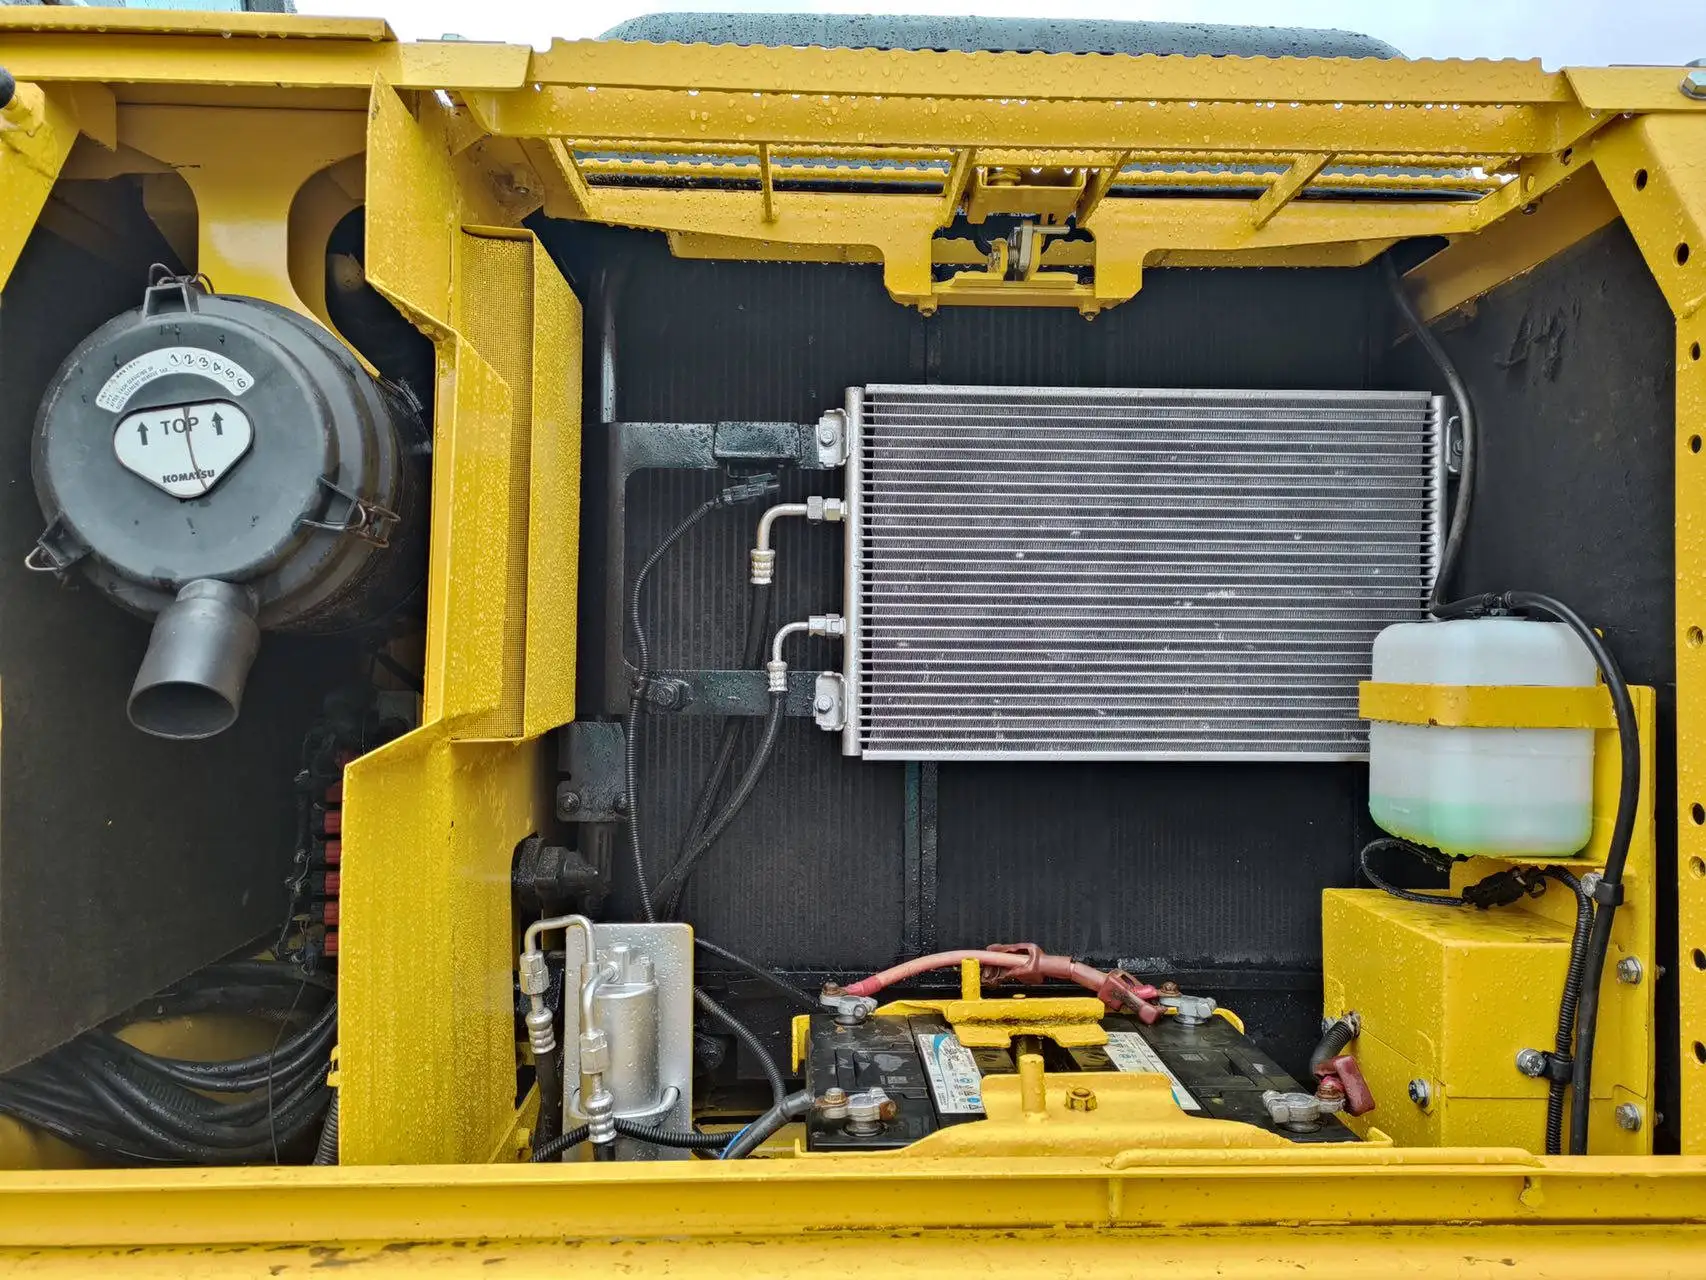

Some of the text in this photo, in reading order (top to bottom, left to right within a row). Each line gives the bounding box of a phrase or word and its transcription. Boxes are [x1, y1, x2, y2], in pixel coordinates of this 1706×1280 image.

[170, 354, 246, 388] 1 2 3 4 5 6
[160, 417, 199, 435] TOP
[162, 469, 215, 483] KOMATSU
